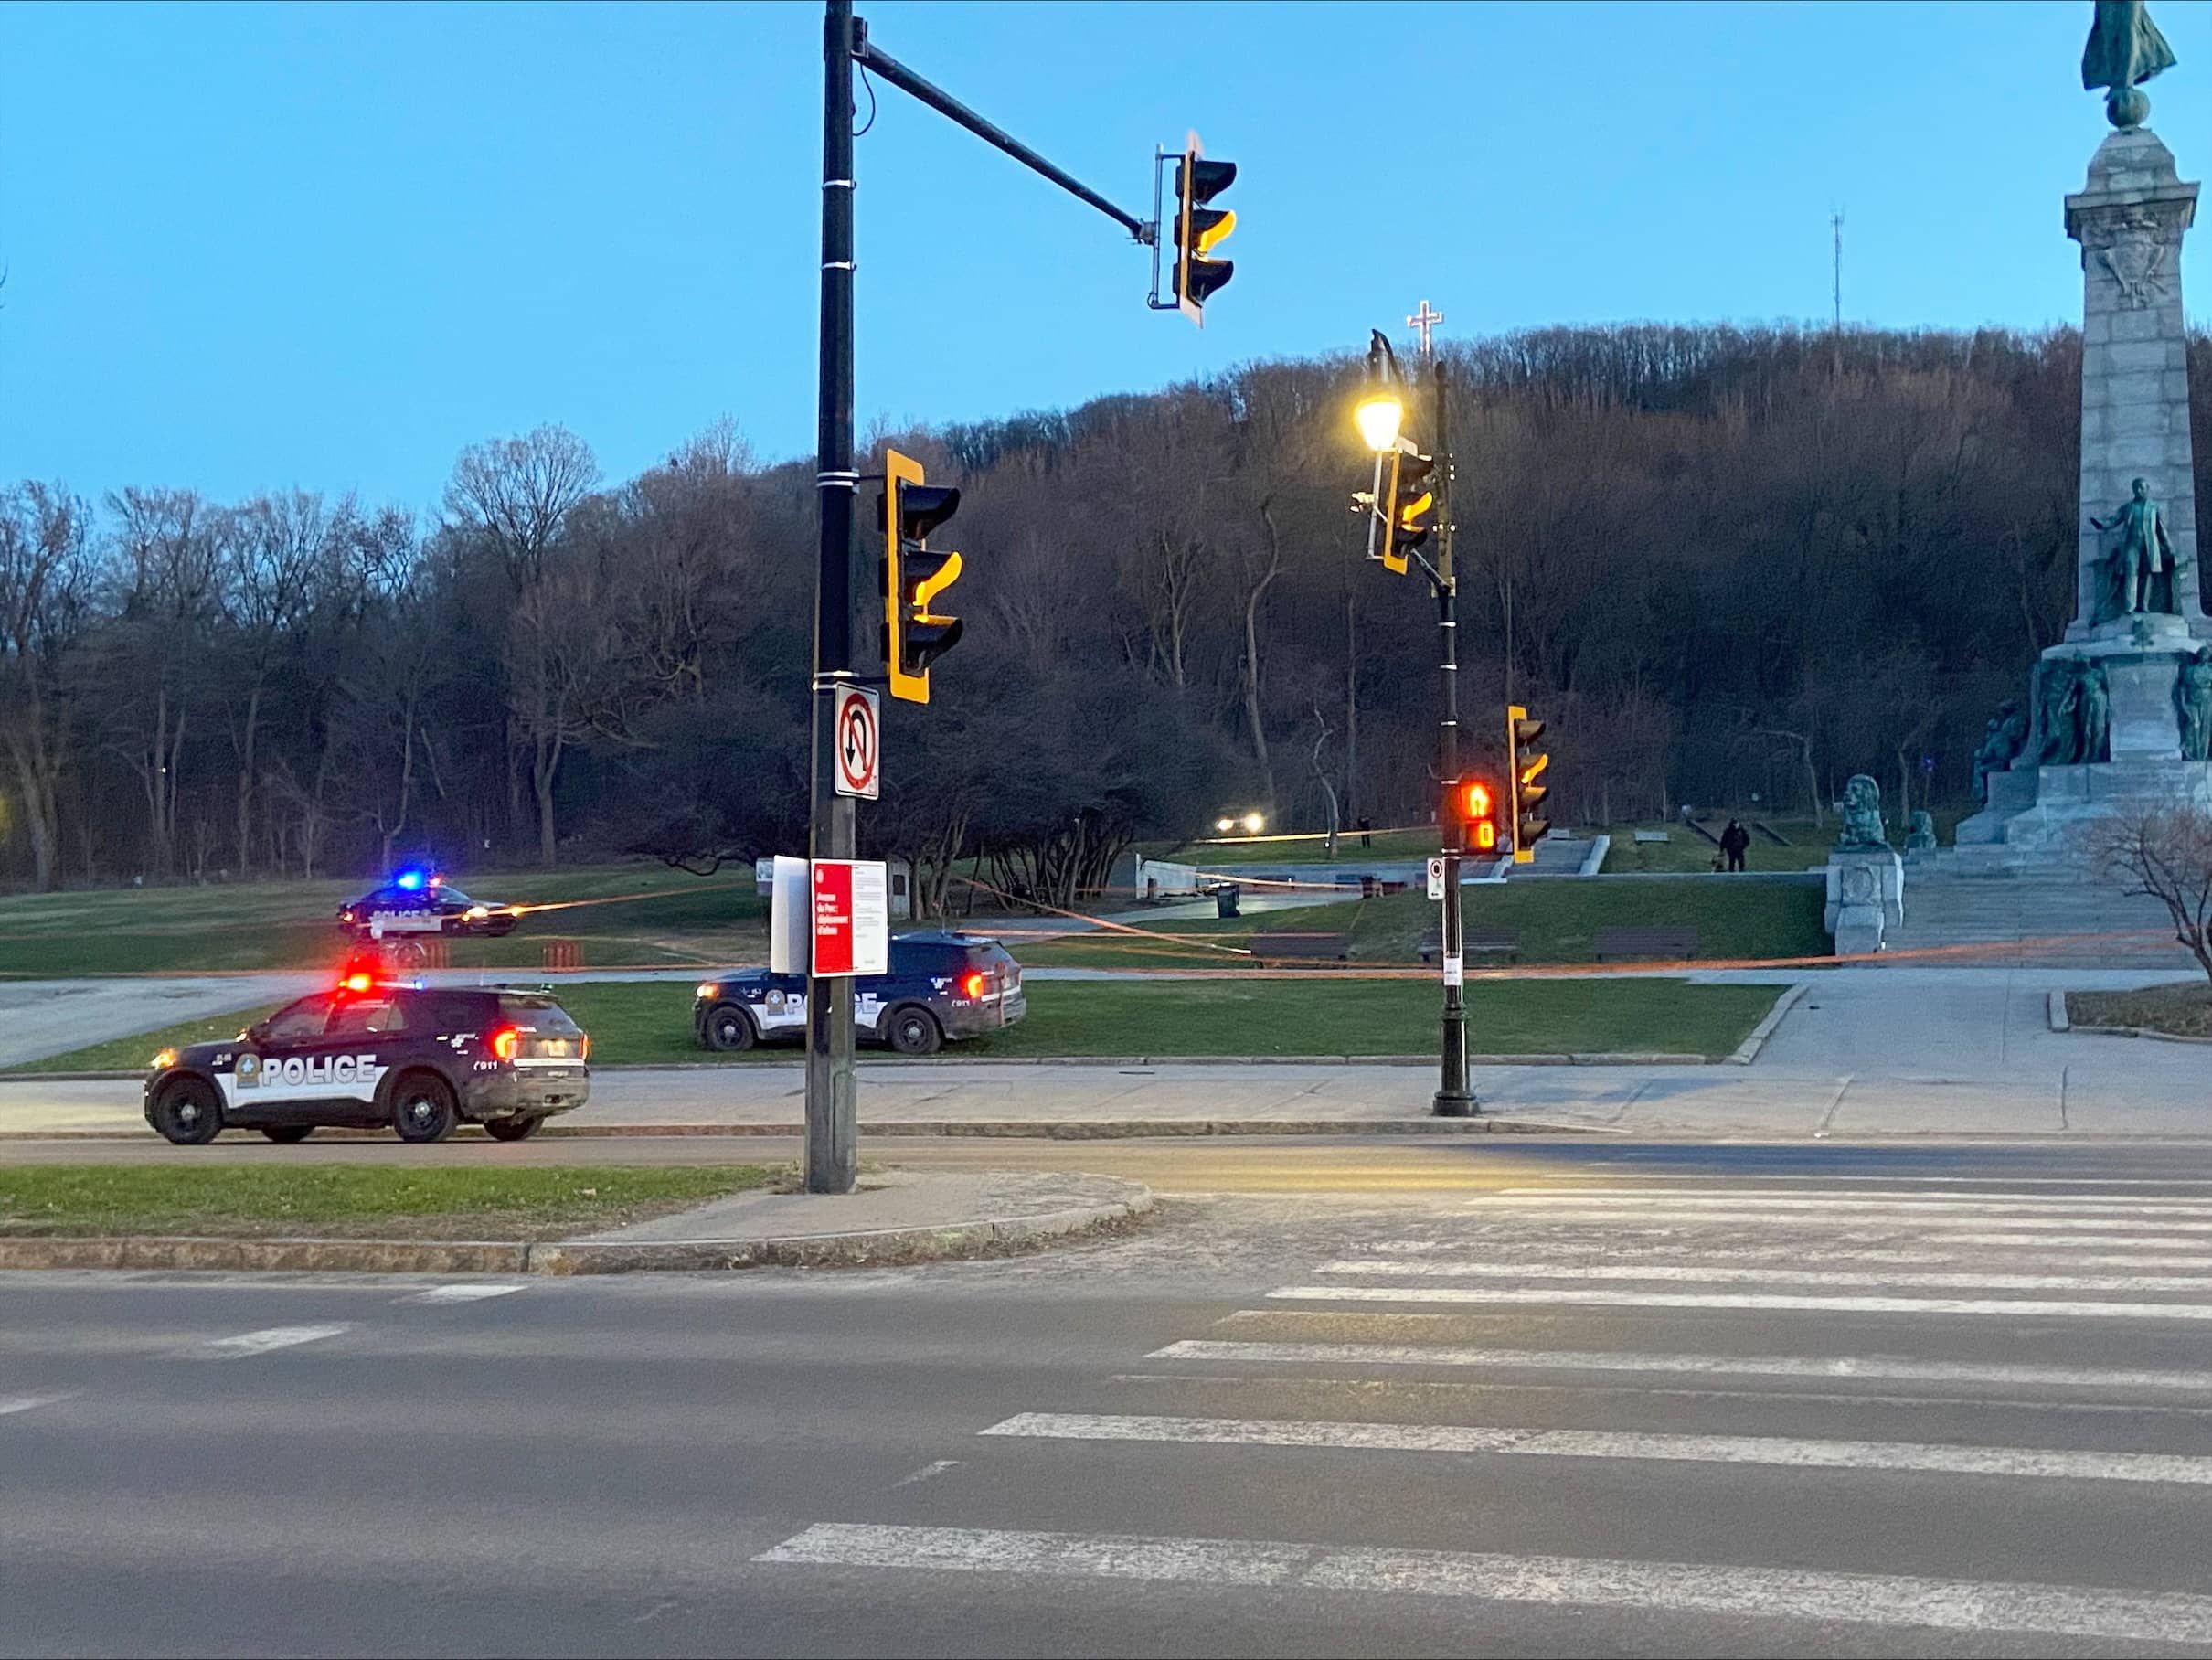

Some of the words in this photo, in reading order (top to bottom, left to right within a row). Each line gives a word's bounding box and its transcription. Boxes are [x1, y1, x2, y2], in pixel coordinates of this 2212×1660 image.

[372, 910, 420, 921] POLICE
[262, 1053, 377, 1088] POLICE
[480, 1060, 498, 1070] 911
